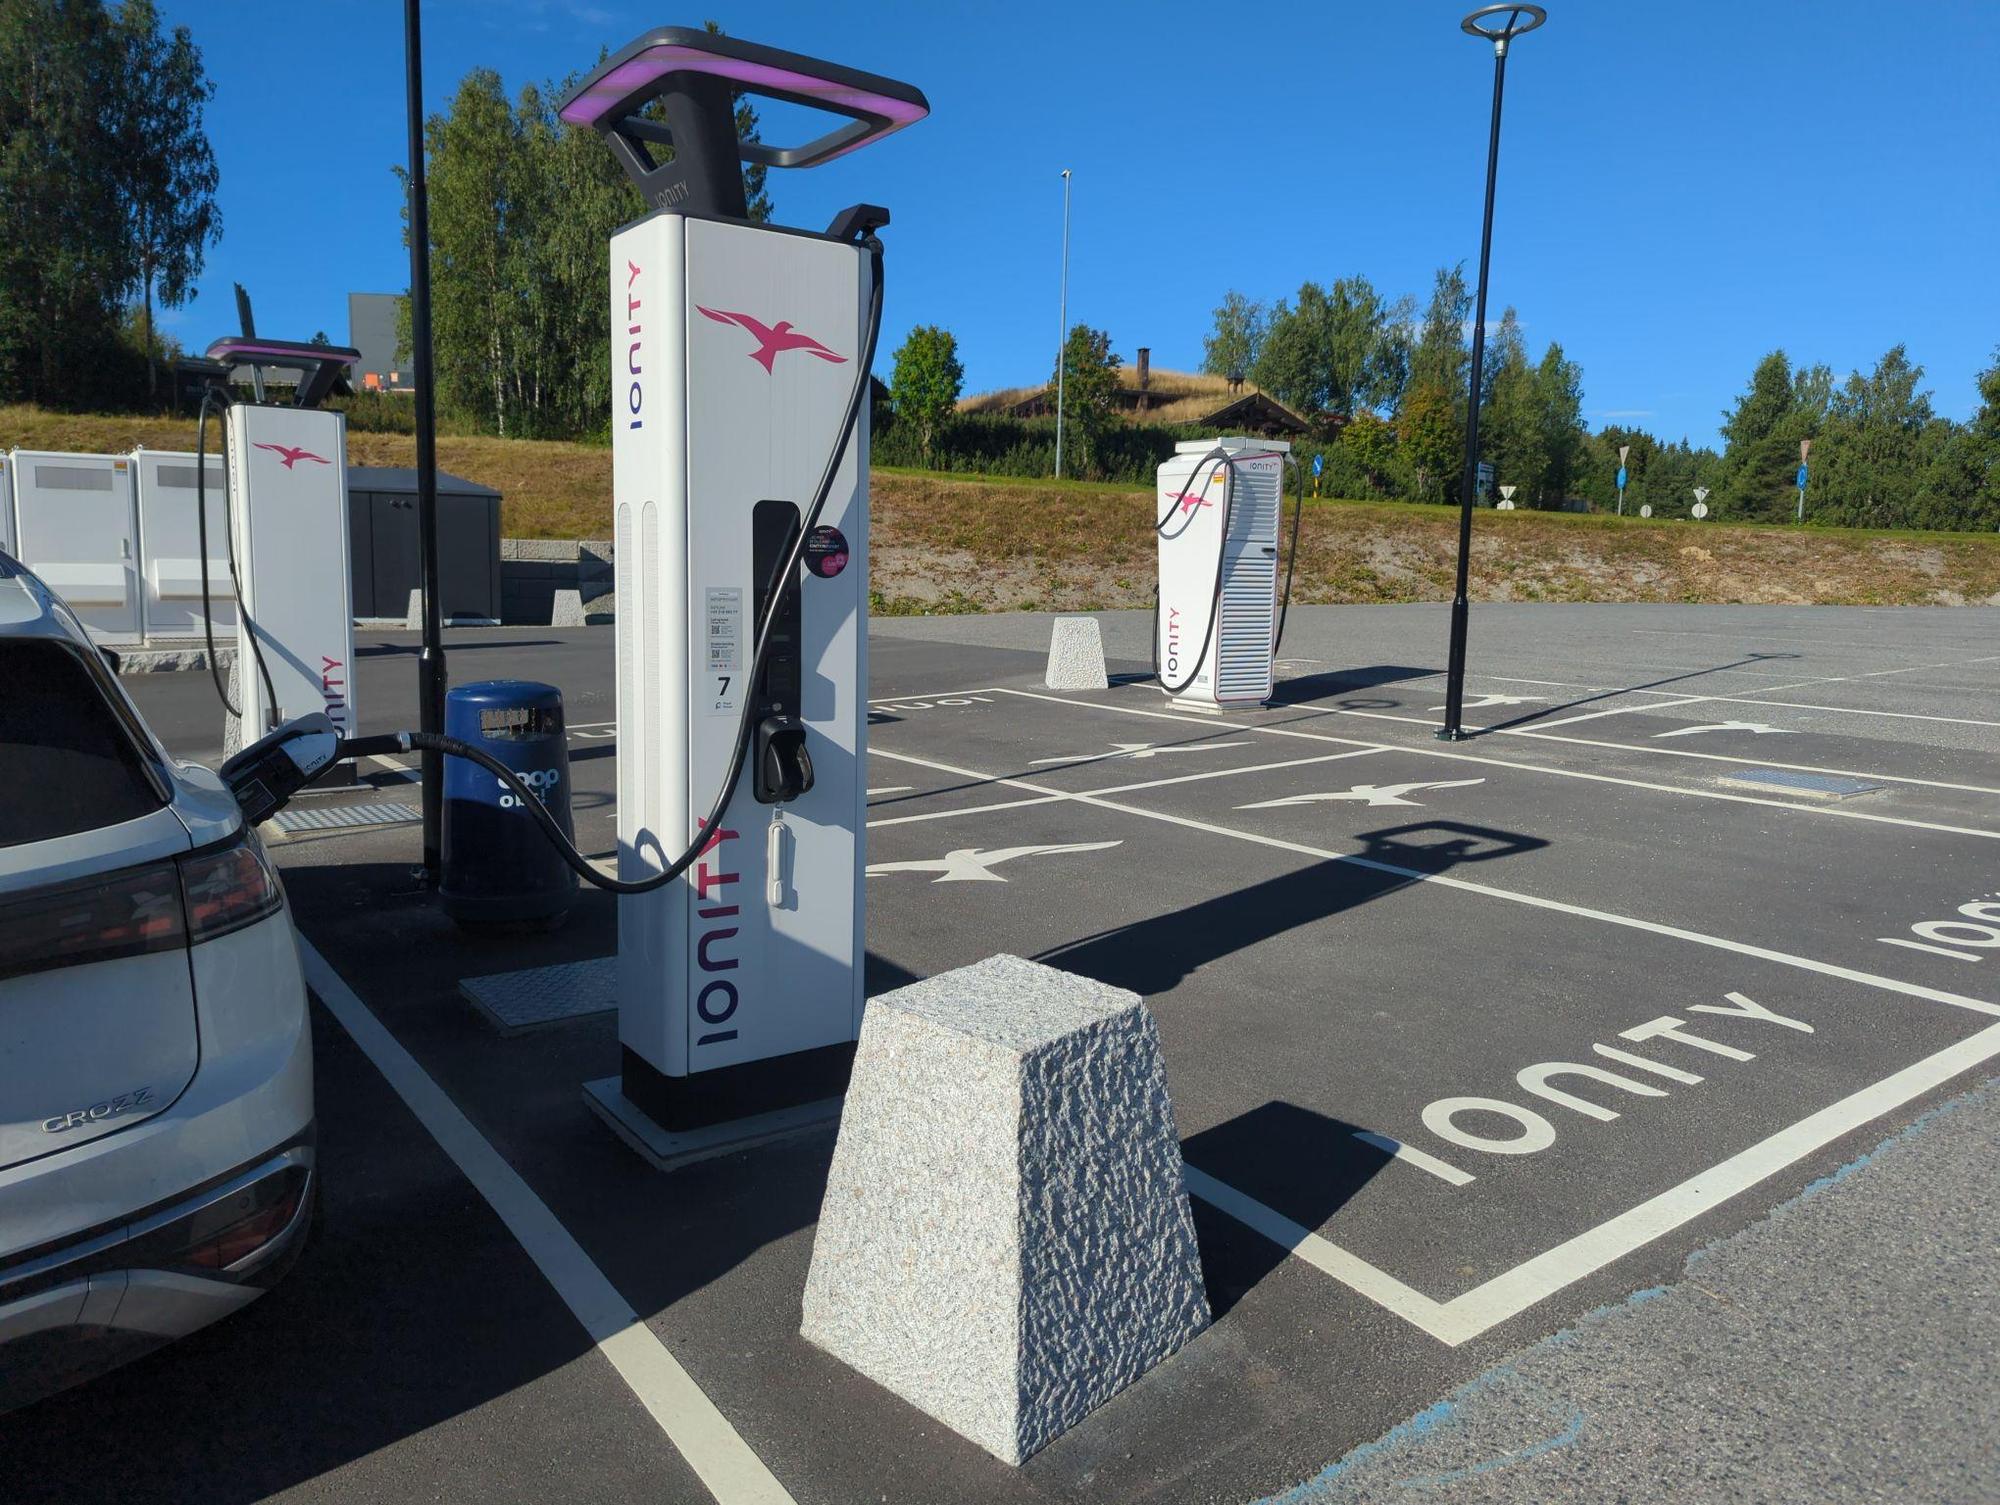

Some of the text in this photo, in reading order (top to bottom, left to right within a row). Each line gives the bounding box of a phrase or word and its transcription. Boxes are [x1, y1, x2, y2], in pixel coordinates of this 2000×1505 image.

[655, 179, 689, 208] IONITY
[627, 259, 642, 430] IONITY
[1249, 462, 1273, 471] IONITY
[1167, 607, 1181, 678] IONITY
[321, 655, 346, 740] ONITY
[717, 676, 731, 697] 7
[696, 816, 741, 1046] IONITY
[40, 1085, 155, 1134] CROZZ
[1352, 990, 1815, 1187] IONITY
